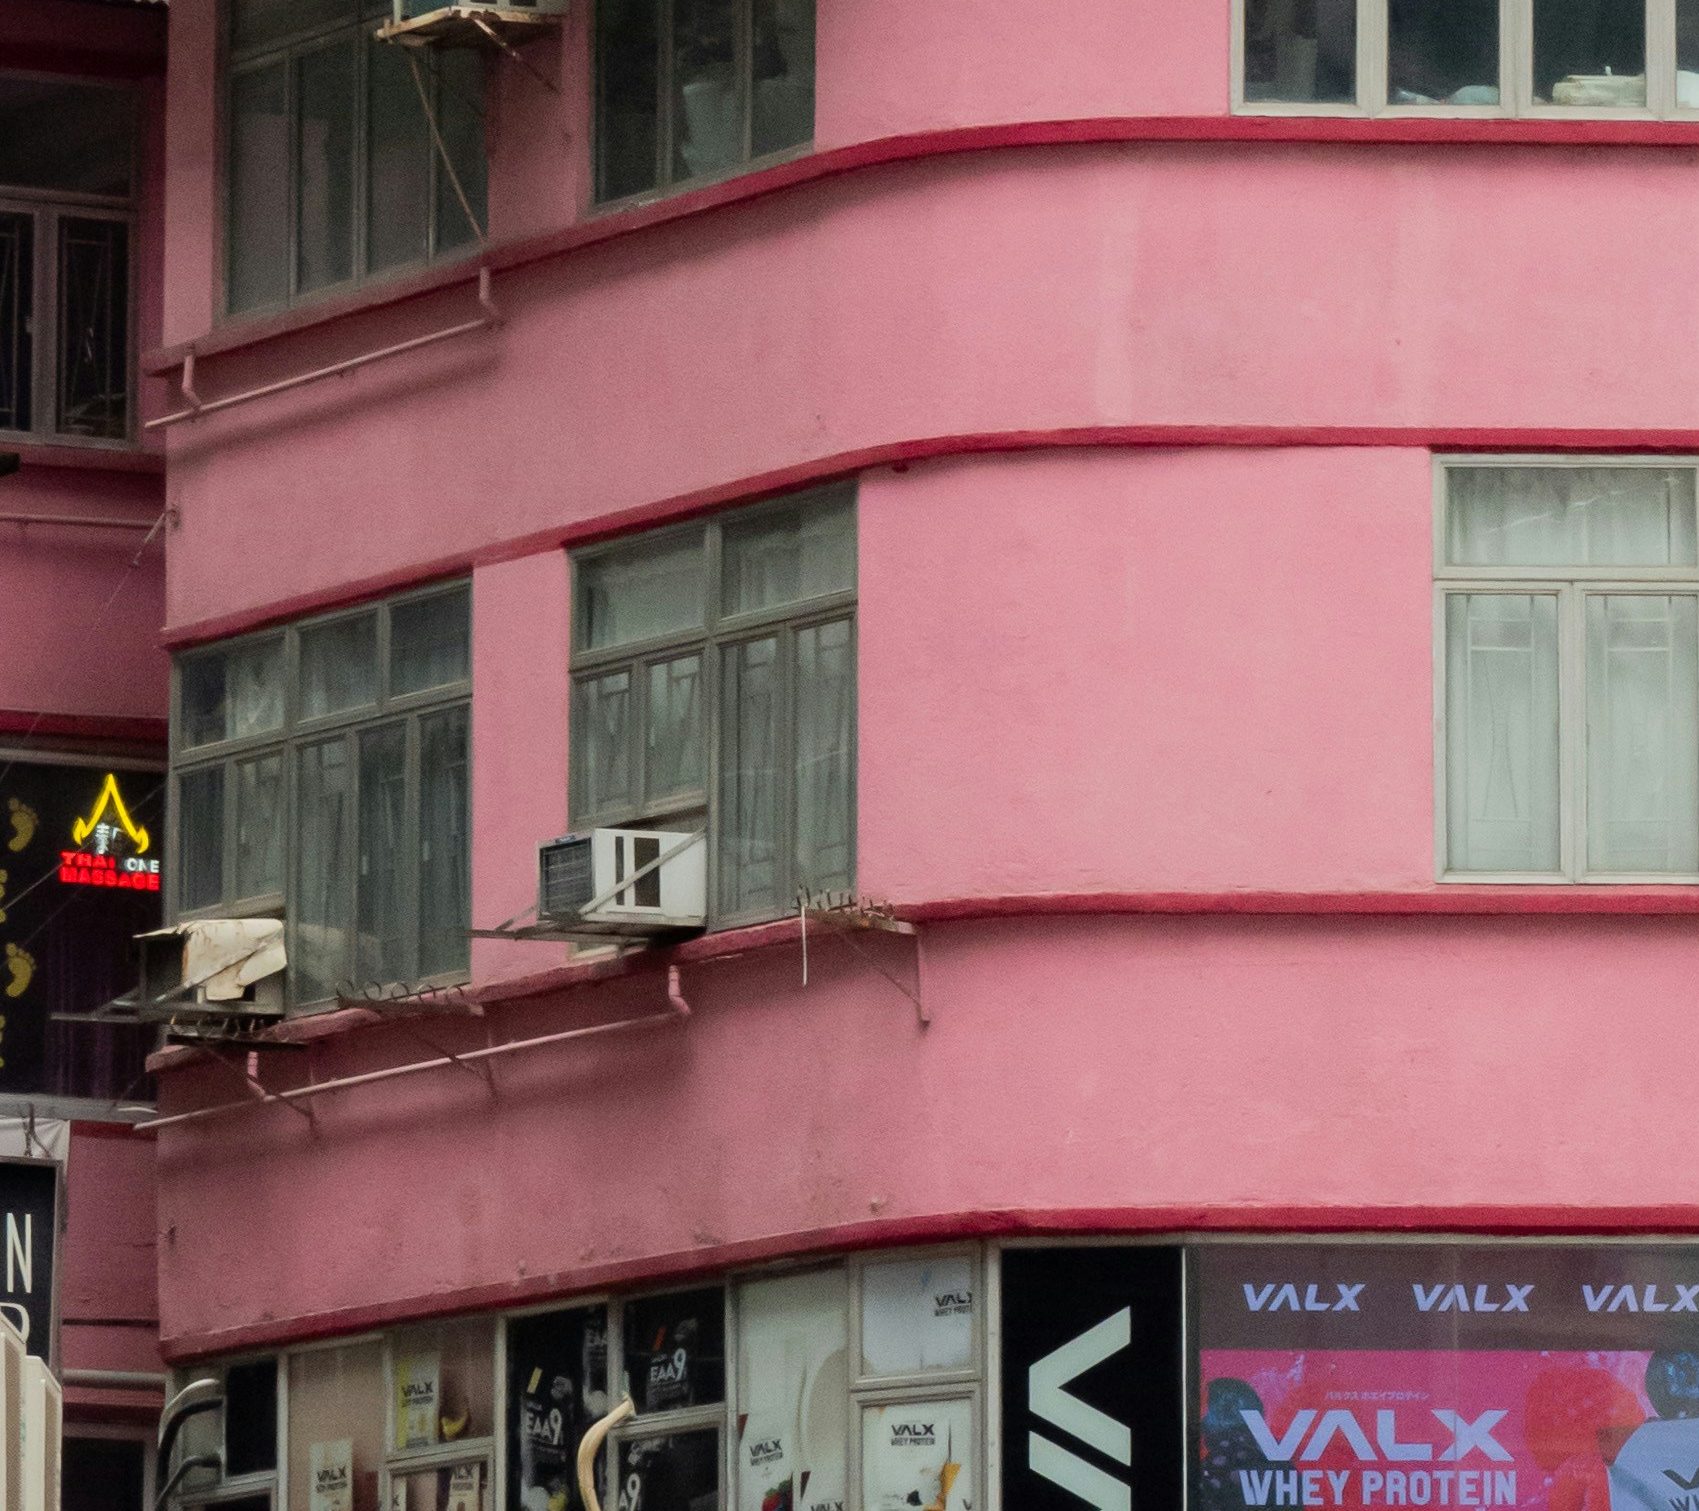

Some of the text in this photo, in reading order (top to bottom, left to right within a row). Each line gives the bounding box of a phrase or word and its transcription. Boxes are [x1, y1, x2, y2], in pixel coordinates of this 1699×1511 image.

[60, 851, 160, 873] THAI ONE
[59, 866, 160, 891] MASSAGE
[1243, 1284, 1365, 1312] VALX
[1412, 1284, 1535, 1312] VALX
[650, 1348, 688, 1383] EAA9
[526, 1407, 562, 1446] EAA9
[891, 1423, 935, 1436] VALX
[1239, 1409, 1515, 1461] VALX
[750, 1439, 782, 1457] VALX
[1239, 1470, 1517, 1506] WHEY PROTEIN
